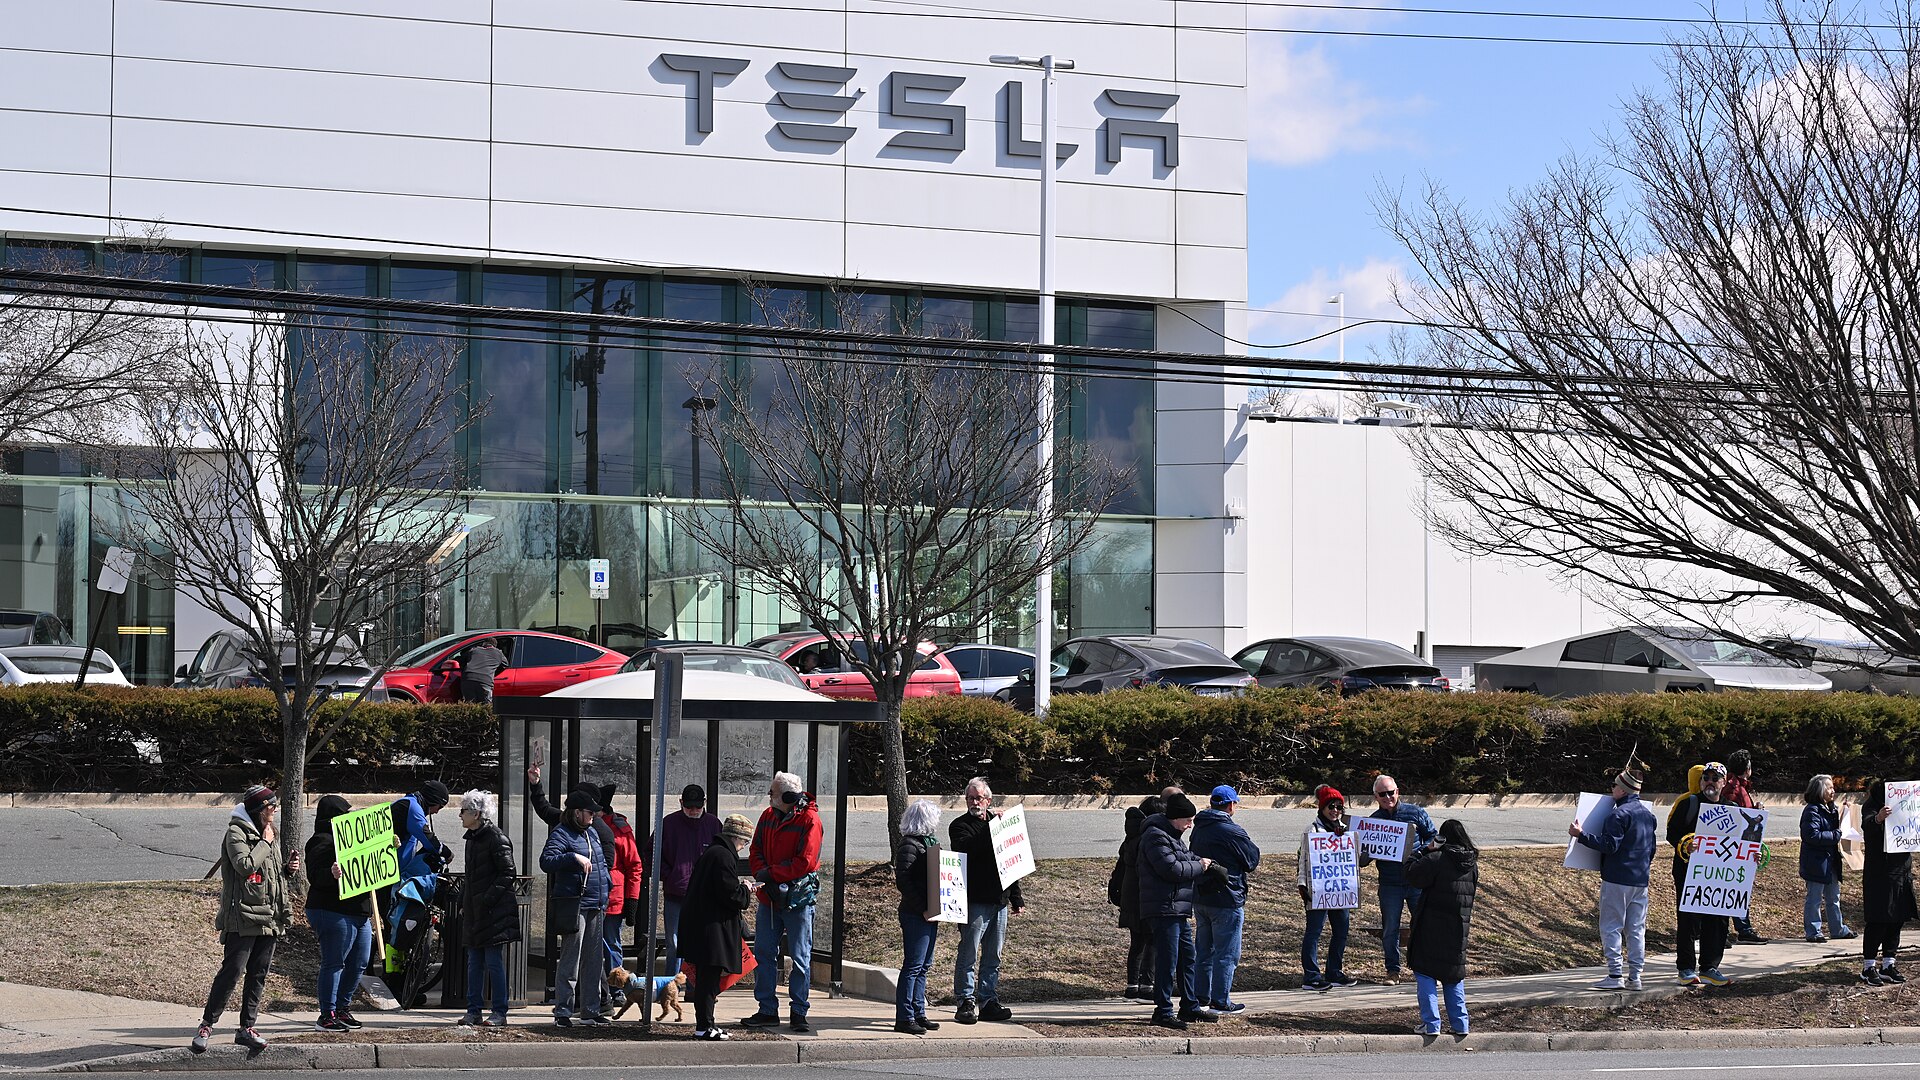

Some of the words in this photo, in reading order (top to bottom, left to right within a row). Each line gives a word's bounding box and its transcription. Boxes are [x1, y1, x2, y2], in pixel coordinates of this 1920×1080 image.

[660, 53, 1180, 168] TESLA
[1699, 805, 1728, 823] WAKE
[336, 819, 354, 851] NO
[355, 806, 393, 844] OLIGARCHS
[1357, 820, 1404, 835] AMERICANS
[1717, 814, 1735, 831] UP!
[1003, 832, 1025, 849] COMMON
[1362, 831, 1400, 844] AGAINST
[1319, 853, 1330, 864] IS
[1331, 851, 1353, 863] THE
[1360, 842, 1397, 858] MUSK!
[340, 857, 361, 894] NO
[360, 844, 397, 888] KINGS
[940, 857, 962, 867] IRES
[1312, 864, 1356, 879] FASCIST
[1693, 865, 1746, 883] FUND$
[1324, 879, 1350, 892] CAR
[1317, 892, 1358, 908] AROUND
[1682, 886, 1748, 910] FASCISM
